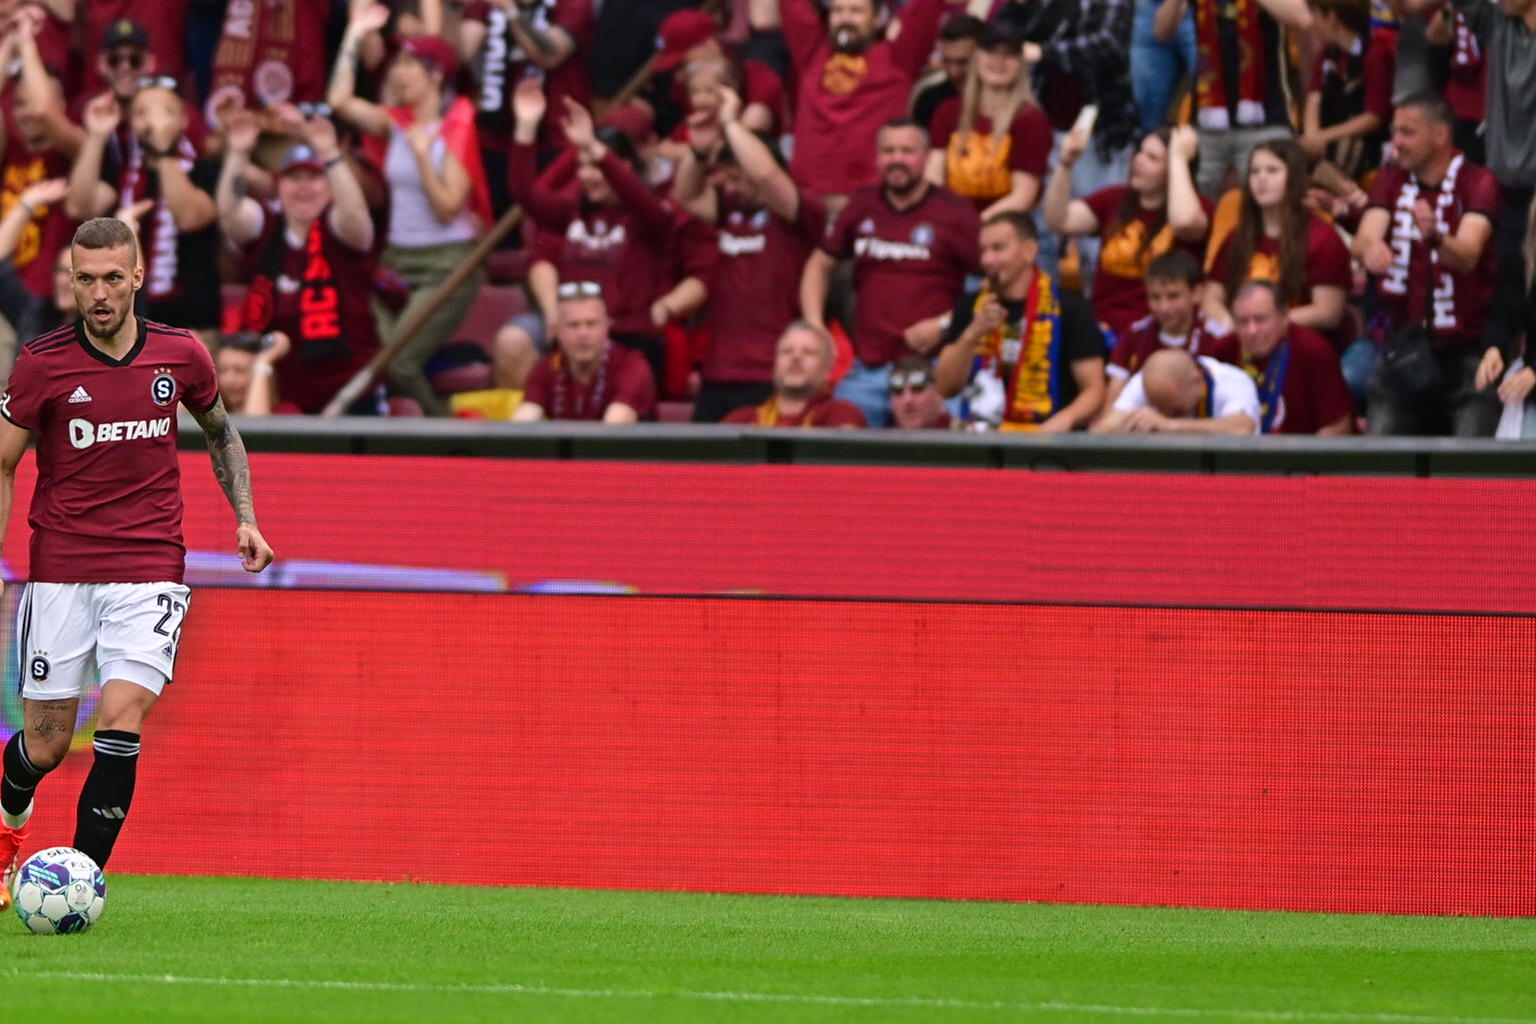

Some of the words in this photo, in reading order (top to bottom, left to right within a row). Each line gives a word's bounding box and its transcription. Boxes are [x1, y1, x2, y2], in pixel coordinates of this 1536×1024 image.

[158, 380, 170, 398] S
[96, 417, 171, 443] BETANO
[33, 661, 46, 677] S
